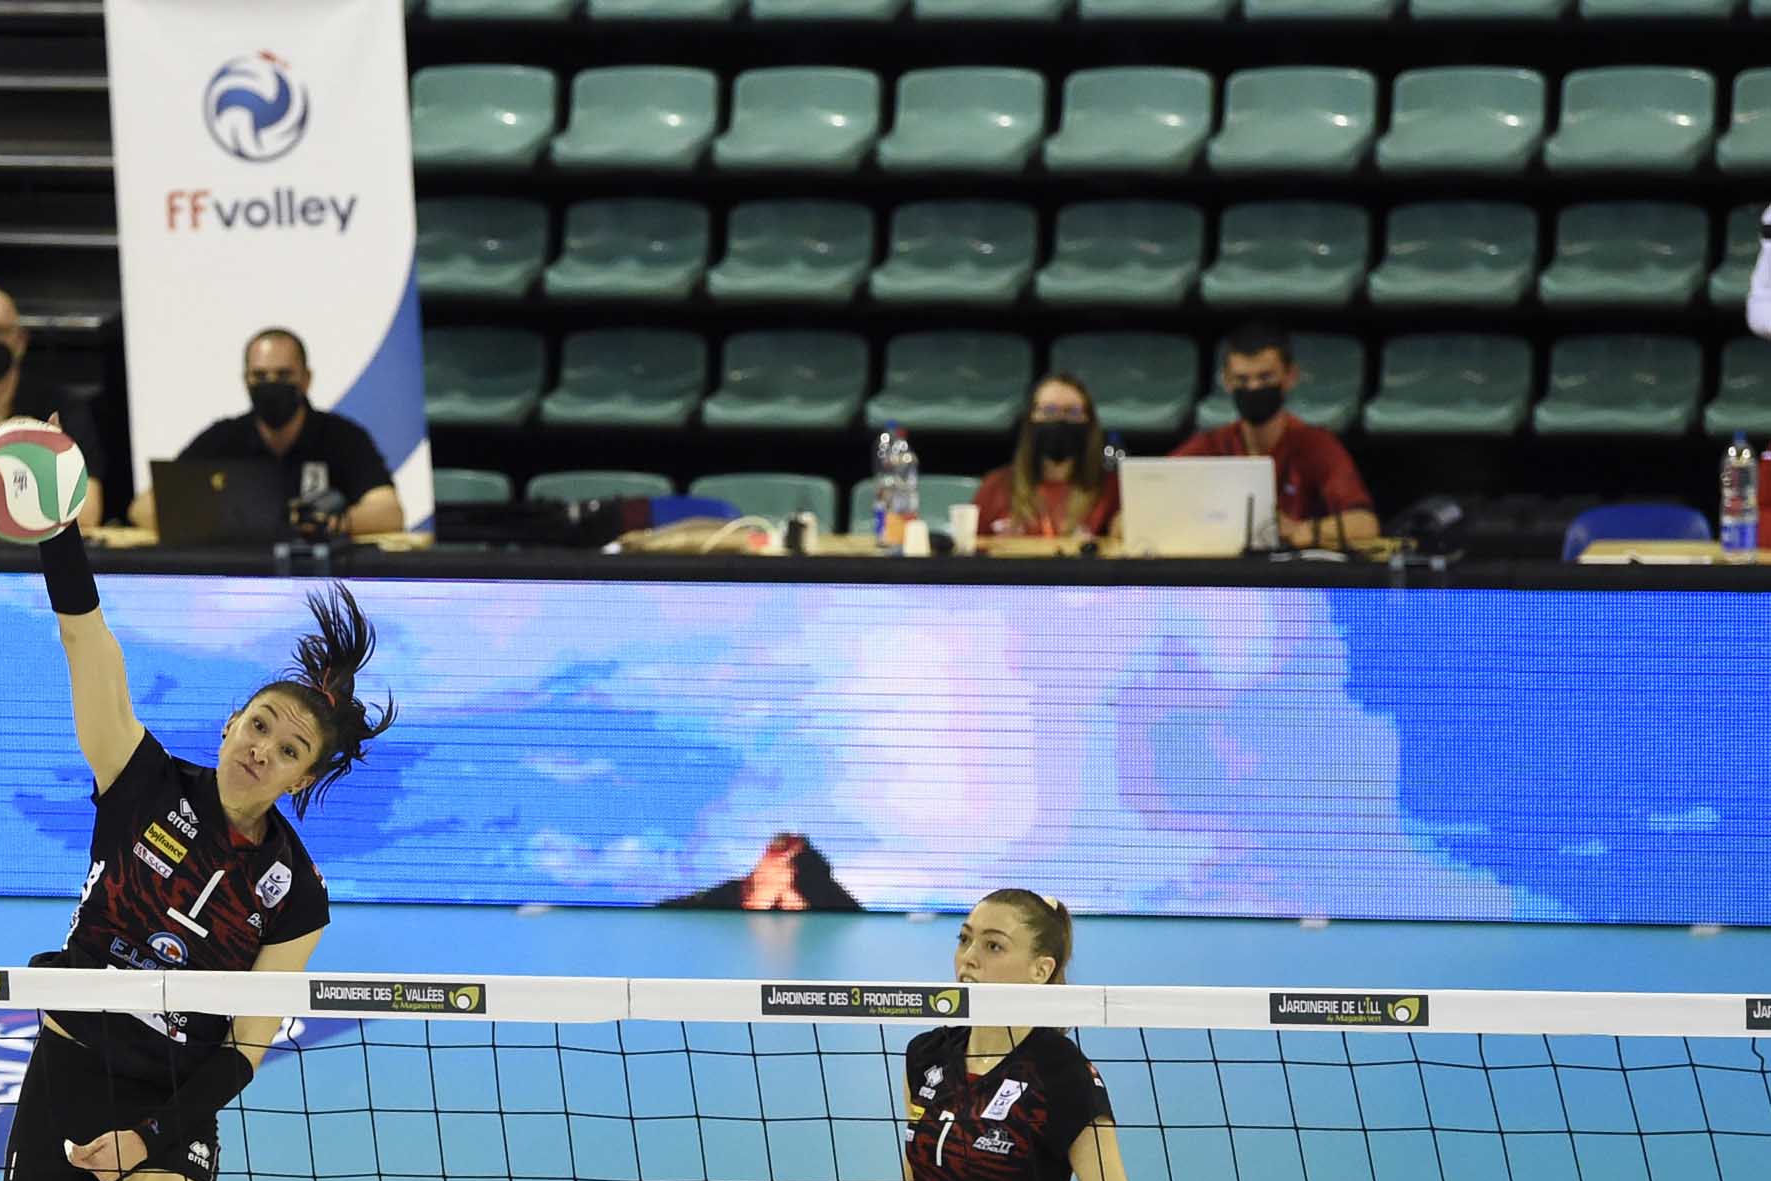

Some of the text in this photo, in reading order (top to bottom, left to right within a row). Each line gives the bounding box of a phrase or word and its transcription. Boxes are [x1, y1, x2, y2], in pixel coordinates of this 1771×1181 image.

[316, 982, 445, 1002] JARDINERIE DES 2 VALLÉES
[768, 986, 923, 1006] JARDINERIE DES 3 FRONTIÈRES
[1279, 995, 1339, 1014] JARDINERIE
[1341, 1000, 1355, 1014] DE
[936, 1110, 955, 1167] 7
